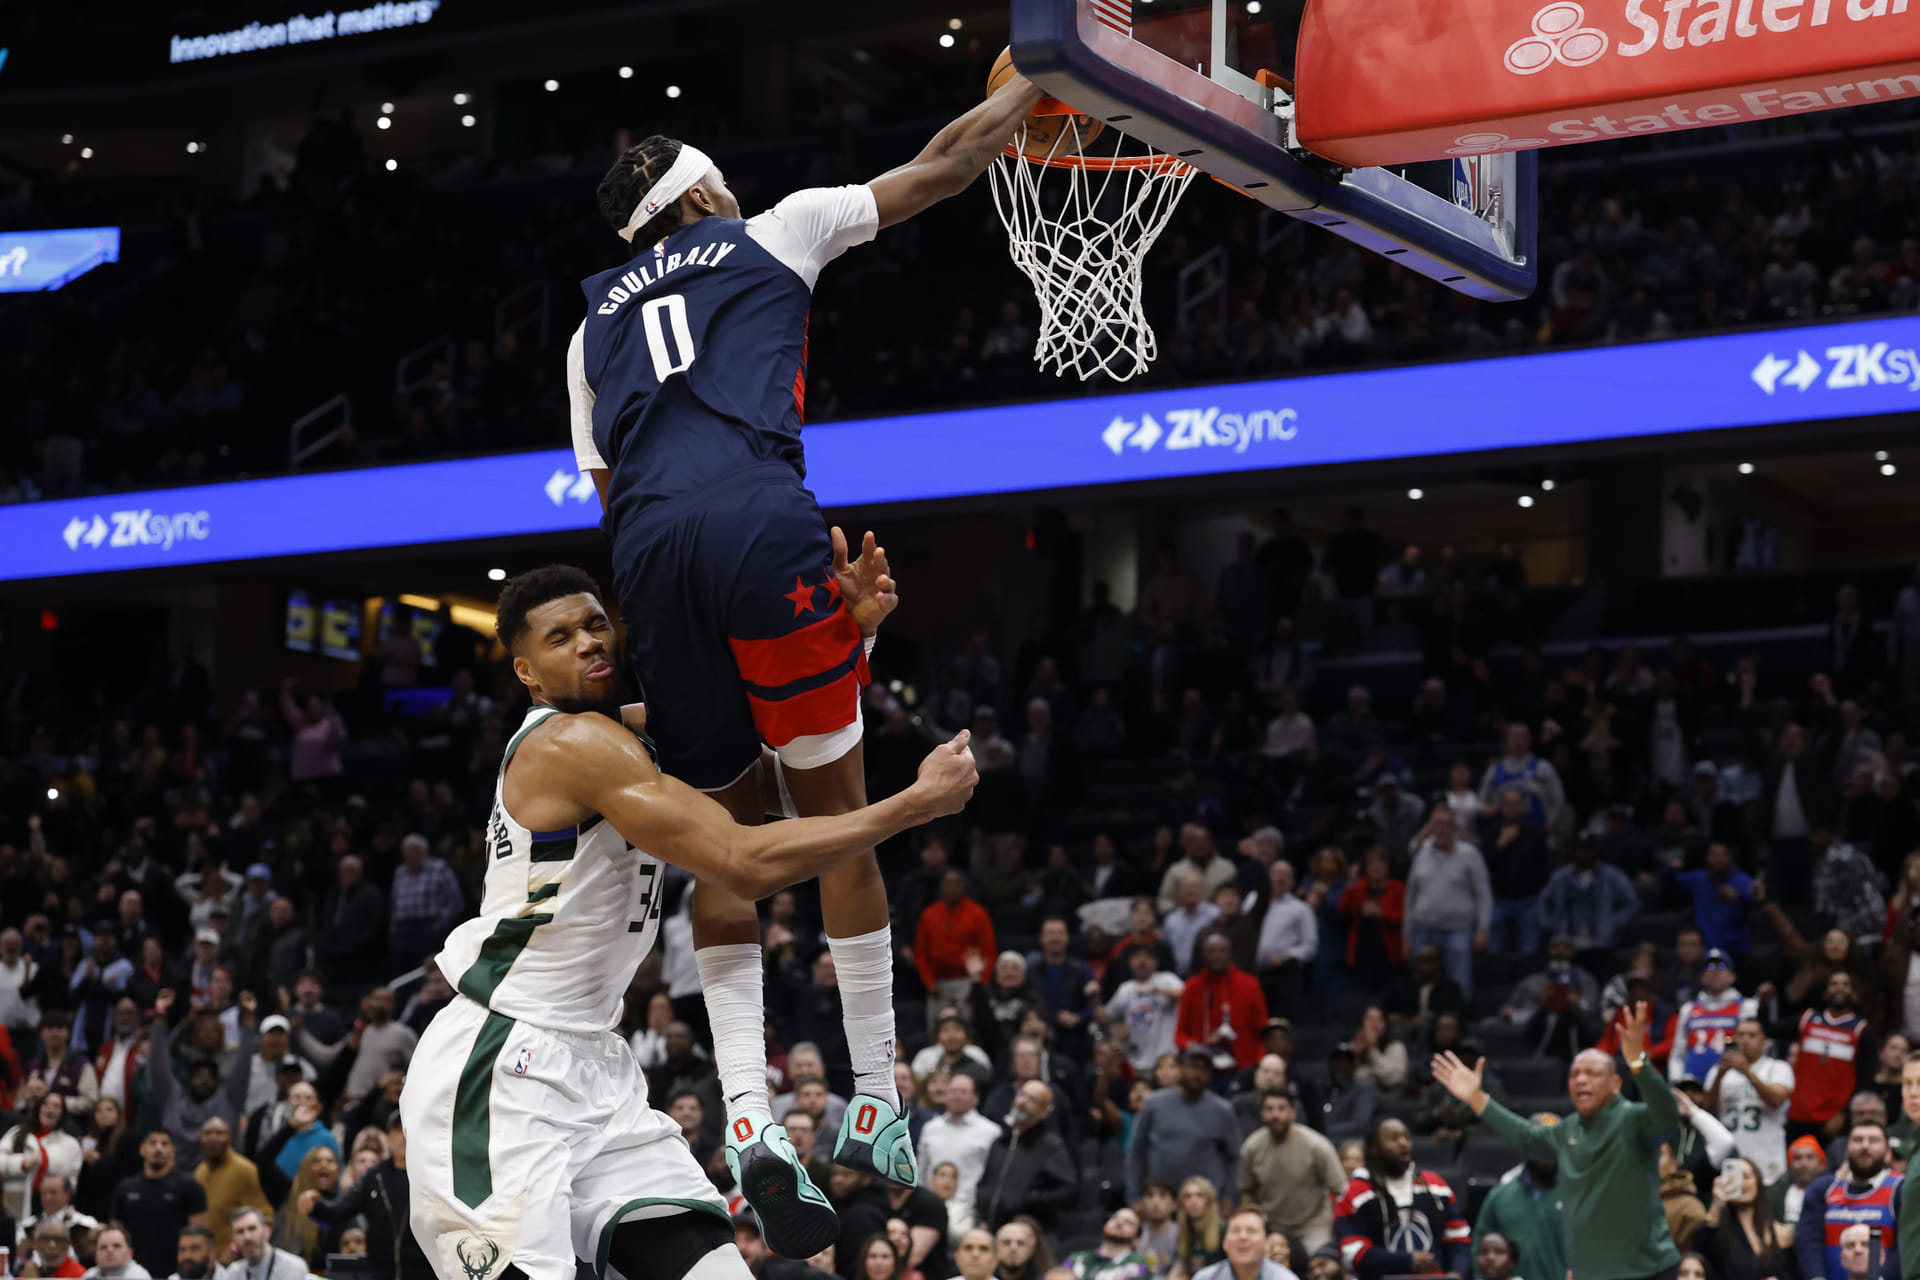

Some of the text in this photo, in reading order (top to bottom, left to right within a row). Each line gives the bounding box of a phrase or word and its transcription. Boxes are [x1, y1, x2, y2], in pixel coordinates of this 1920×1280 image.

[170, 21, 287, 64] Innovation
[288, 10, 336, 44] that
[597, 242, 736, 315] COULIBALY
[641, 294, 695, 383] 0
[1165, 406, 1298, 454] ZKsync
[109, 508, 211, 551] ZKsync
